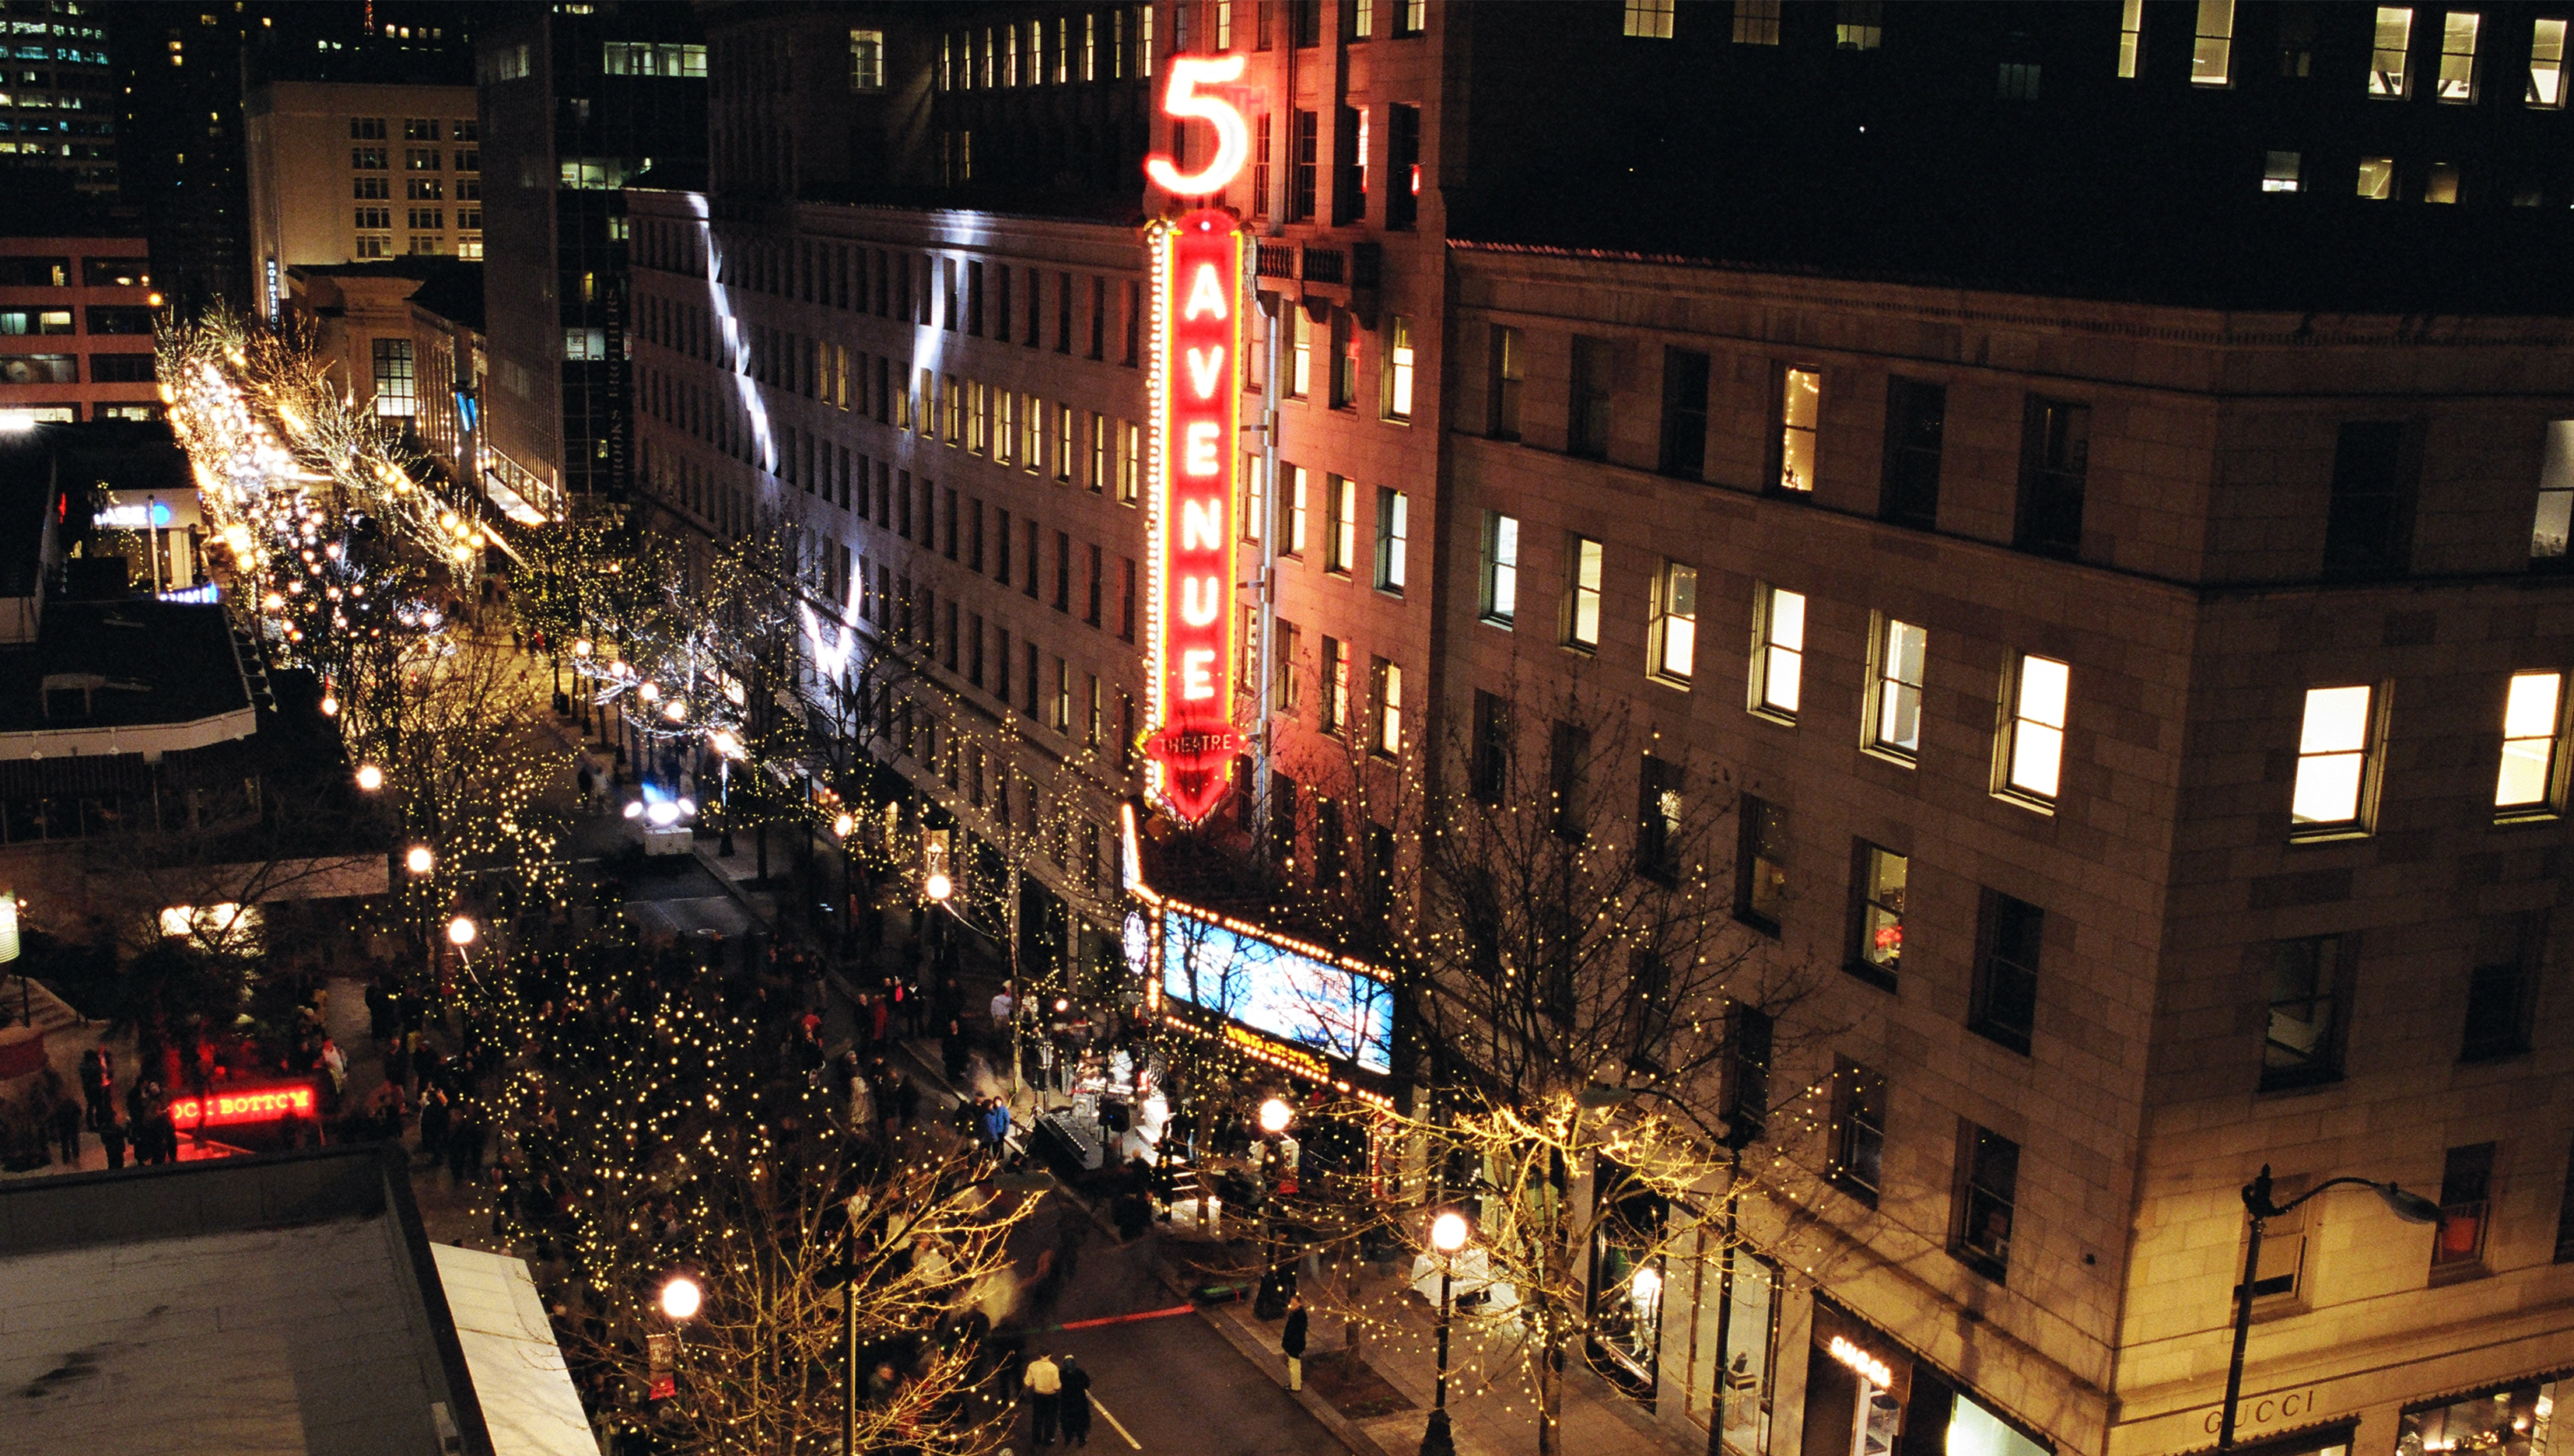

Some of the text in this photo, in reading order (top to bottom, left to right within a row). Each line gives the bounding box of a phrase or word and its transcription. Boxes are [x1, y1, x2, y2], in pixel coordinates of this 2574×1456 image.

[1183, 262, 1227, 700] AVENUE
[1157, 733, 1232, 753] THEATRE
[1831, 1336, 1891, 1388] GUCCI
[2204, 1390, 2313, 1434] GUCCI
